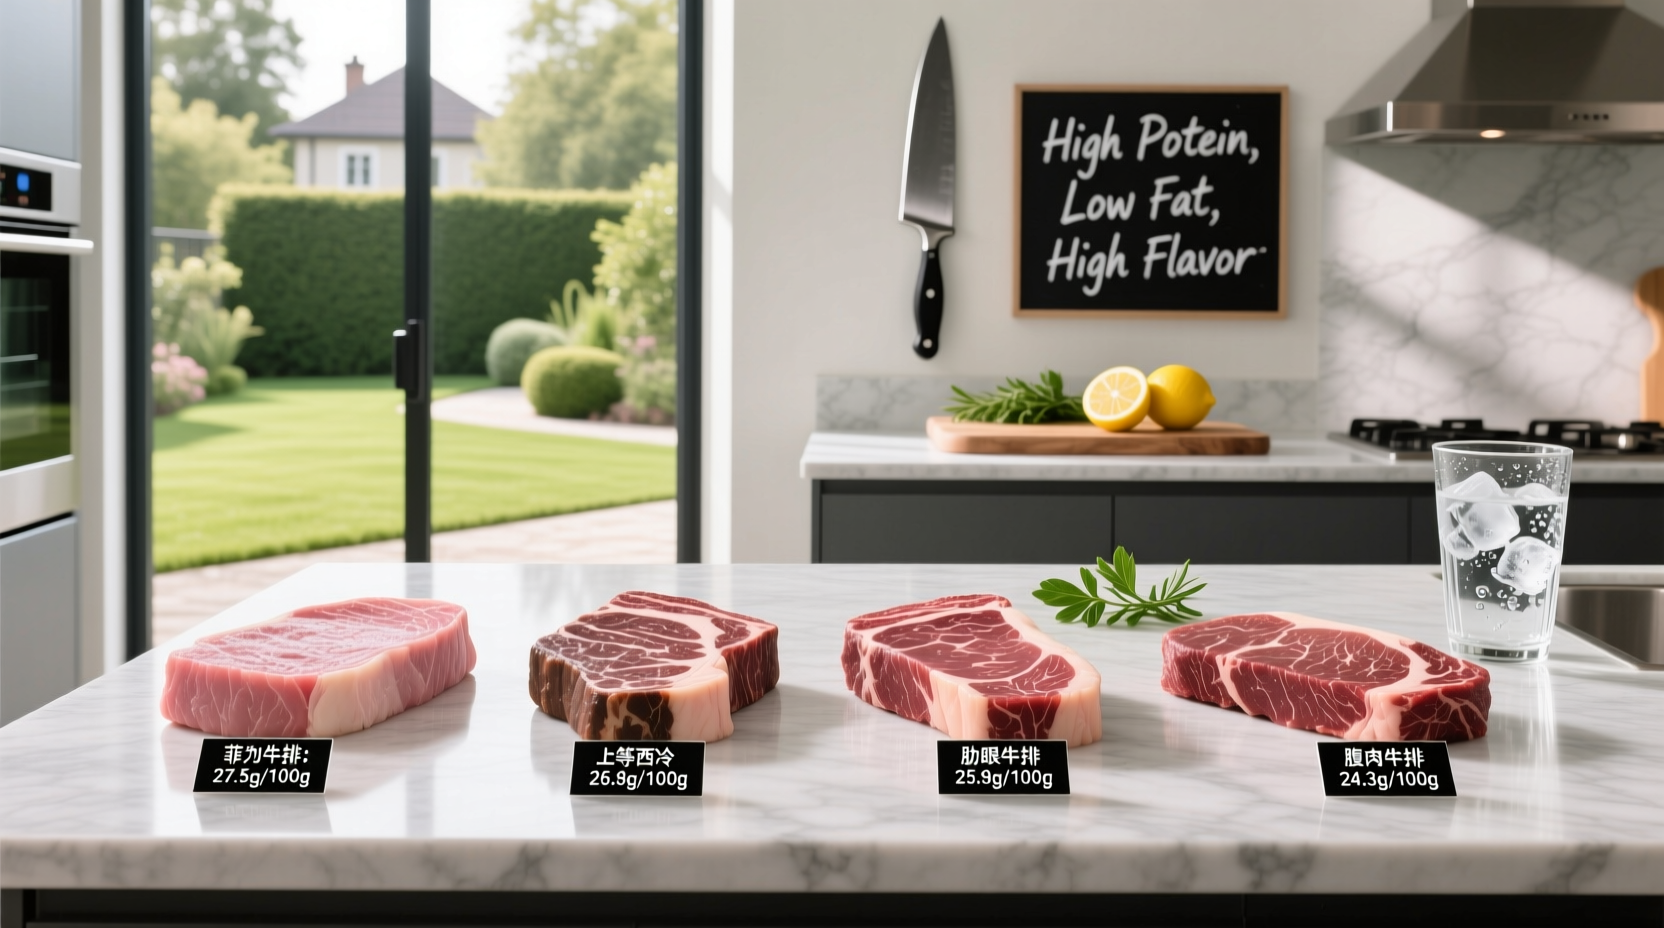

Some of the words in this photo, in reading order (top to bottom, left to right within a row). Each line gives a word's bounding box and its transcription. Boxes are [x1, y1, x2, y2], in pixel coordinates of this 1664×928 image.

[1042, 114, 1123, 180] High
[1136, 113, 1260, 164] Potein,
[1060, 178, 1136, 226] Low
[1149, 174, 1220, 227] Fat,
[1046, 231, 1130, 297] High
[596, 746, 675, 768] 上等西冷
[960, 745, 1041, 767] 肋眼牛排
[1344, 747, 1425, 769] 腹肉牛排
[212, 767, 311, 788] 27.5g/100g
[955, 768, 1053, 790] 25.9g/100g
[1339, 769, 1439, 791] 24.3g/100g
